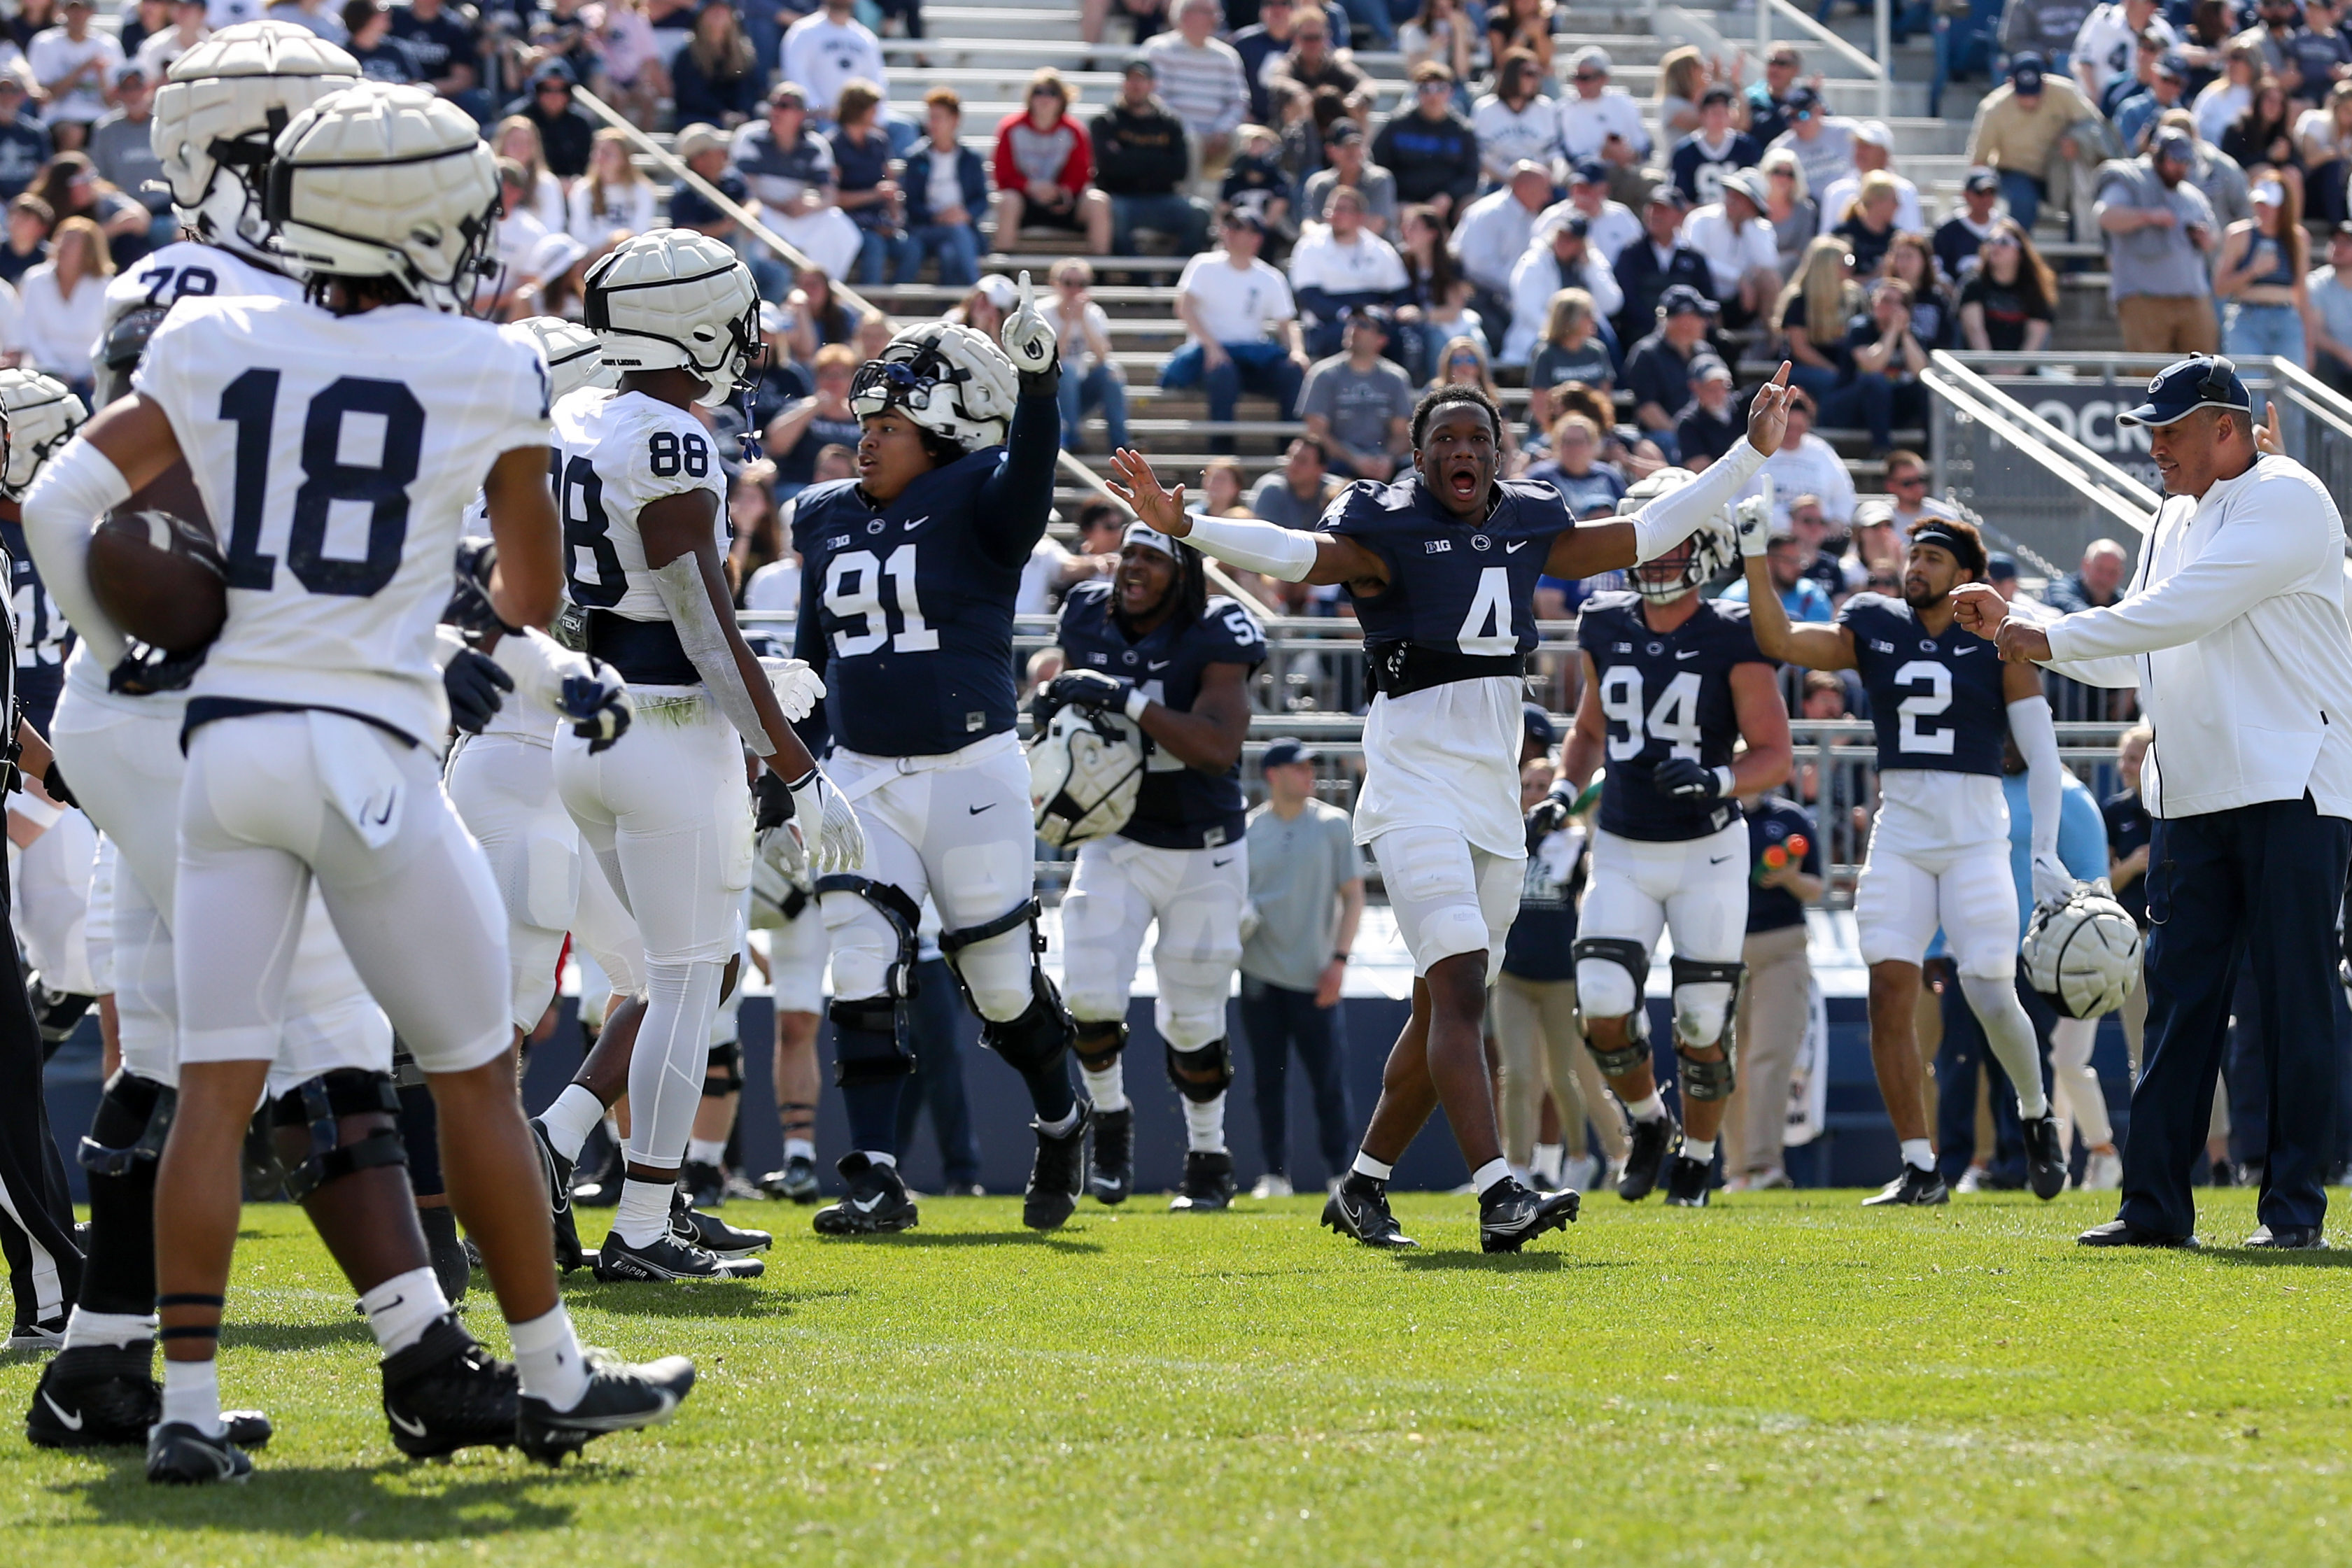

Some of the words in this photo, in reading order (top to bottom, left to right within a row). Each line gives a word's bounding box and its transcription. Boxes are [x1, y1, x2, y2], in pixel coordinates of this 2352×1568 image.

[218, 367, 426, 599] 18
[649, 432, 708, 478] 88
[823, 543, 940, 658] 91
[1456, 567, 1519, 656] 4
[1600, 665, 1703, 765] 94
[1894, 660, 1955, 755] 2
